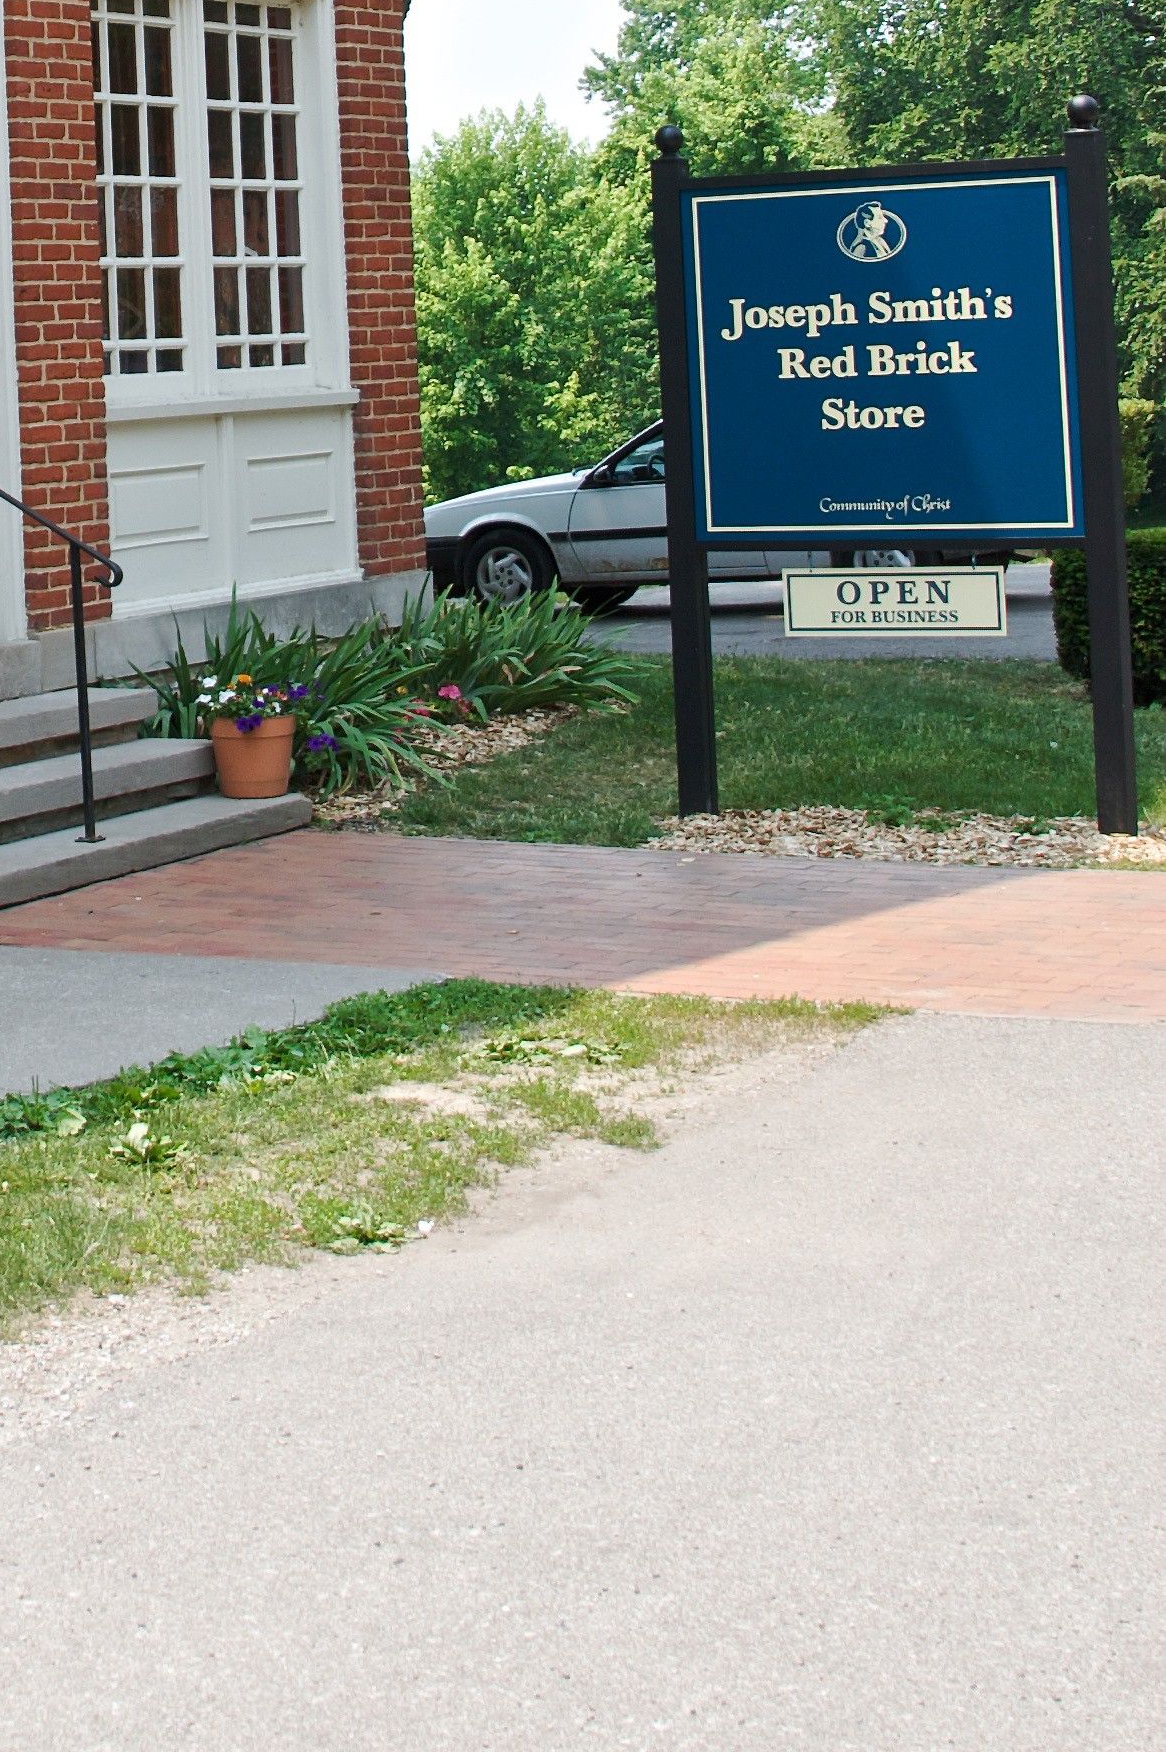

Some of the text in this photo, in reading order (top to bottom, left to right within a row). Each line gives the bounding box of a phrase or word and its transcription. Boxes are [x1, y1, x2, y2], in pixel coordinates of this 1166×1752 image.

[721, 287, 1013, 341] Joseph Smith's
[777, 341, 978, 379] Red Brick
[821, 398, 925, 430] Store
[819, 493, 951, 520] Community of Christ
[836, 580, 951, 605] OPEN
[830, 609, 959, 623] FOR BUSINESS
